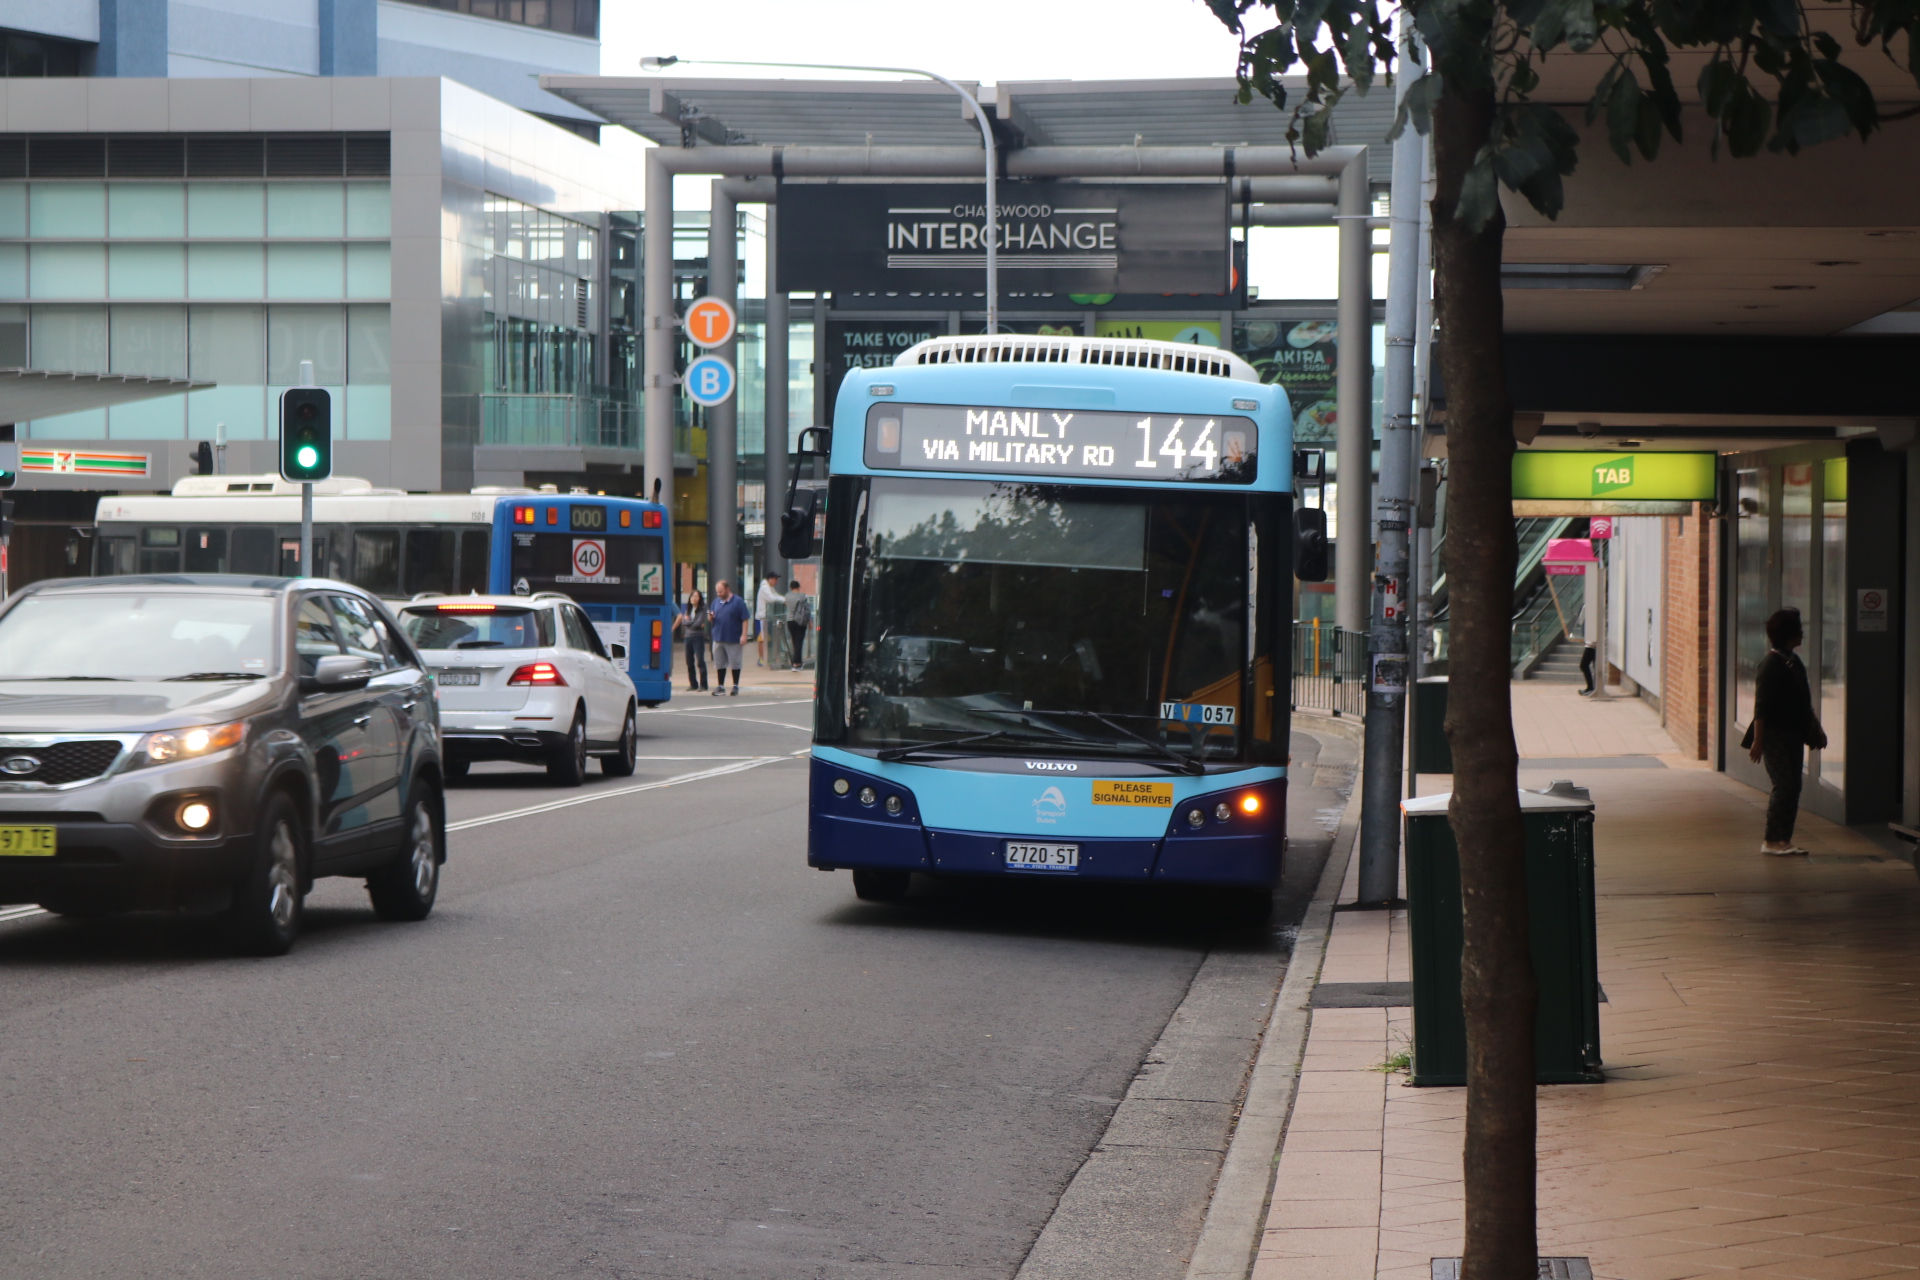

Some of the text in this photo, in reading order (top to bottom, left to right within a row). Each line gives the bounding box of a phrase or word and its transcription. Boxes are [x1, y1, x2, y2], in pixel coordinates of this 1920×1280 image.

[888, 222, 1116, 250] INTERCHANGE
[700, 311, 720, 338] T
[844, 333, 883, 347] TAKE
[1273, 350, 1325, 364] AKIRA
[1303, 364, 1330, 372] SUSHI
[701, 368, 720, 395] B
[966, 410, 1073, 438] MANLY
[1135, 417, 1217, 470] 144
[923, 439, 1115, 466] VIA MILITARY RD
[1595, 468, 1631, 484] TAB
[572, 509, 602, 528] 000
[578, 550, 600, 567] 40
[1182, 705, 1191, 721] V
[1204, 706, 1235, 723] 057
[1024, 761, 1078, 772] VOLVO
[1113, 783, 1153, 793] PLEASE
[1094, 793, 1172, 805] SIGNAL DRIVER
[1036, 809, 1066, 817] Transport
